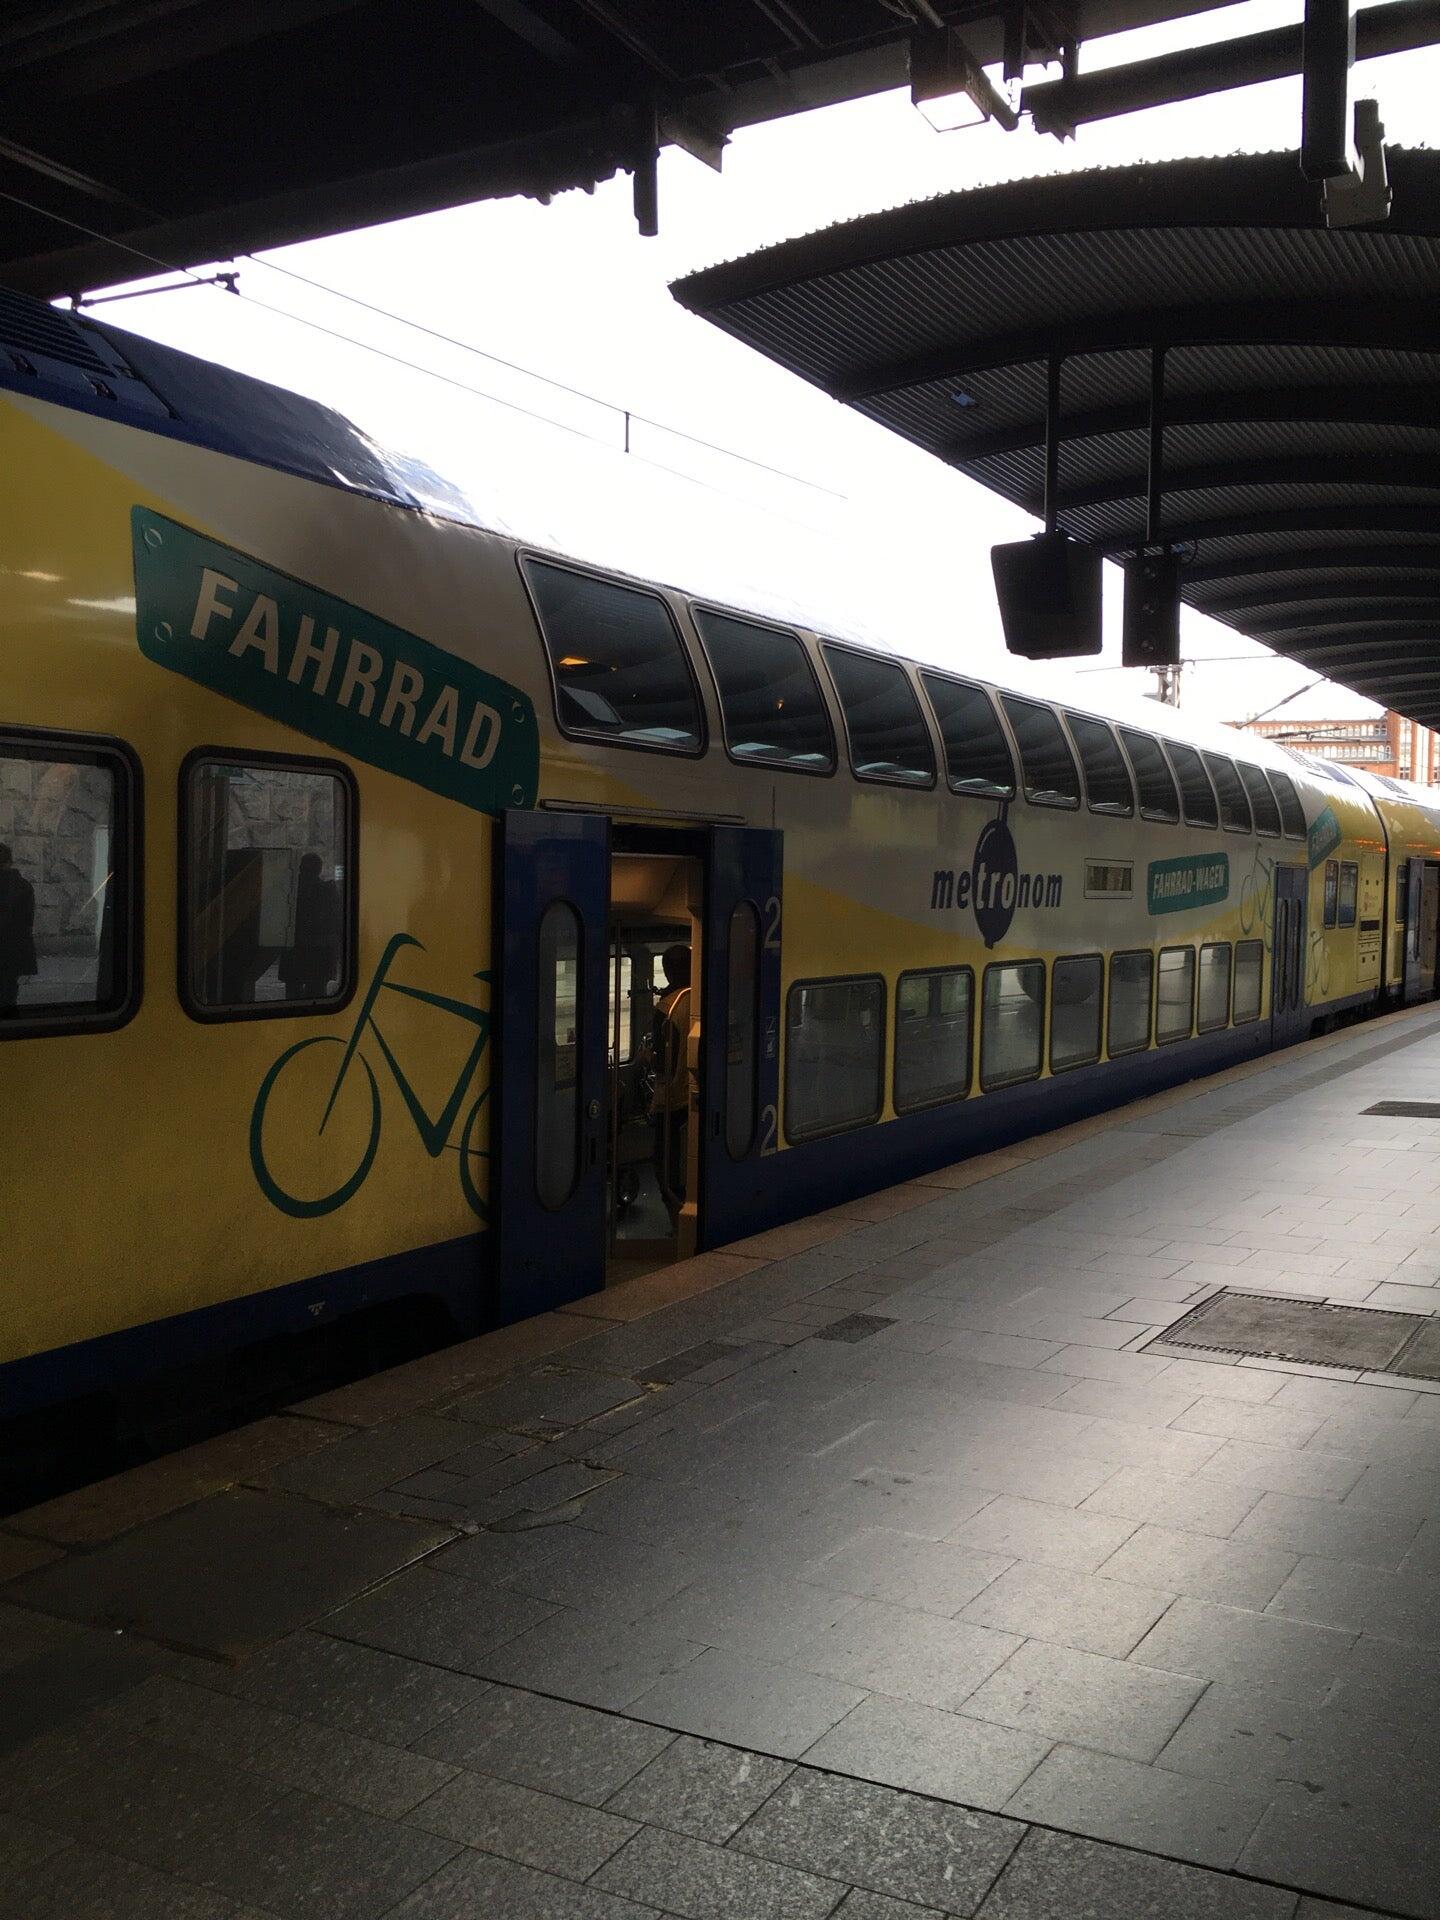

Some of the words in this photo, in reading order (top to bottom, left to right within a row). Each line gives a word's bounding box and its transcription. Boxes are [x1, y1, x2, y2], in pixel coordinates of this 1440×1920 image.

[190, 567, 502, 770] FAHRRAD
[930, 862, 1063, 910] metronom
[1152, 864, 1225, 899] FAHRRAD-WAGEN
[764, 896, 781, 949] 2
[760, 1104, 777, 1157] 2
